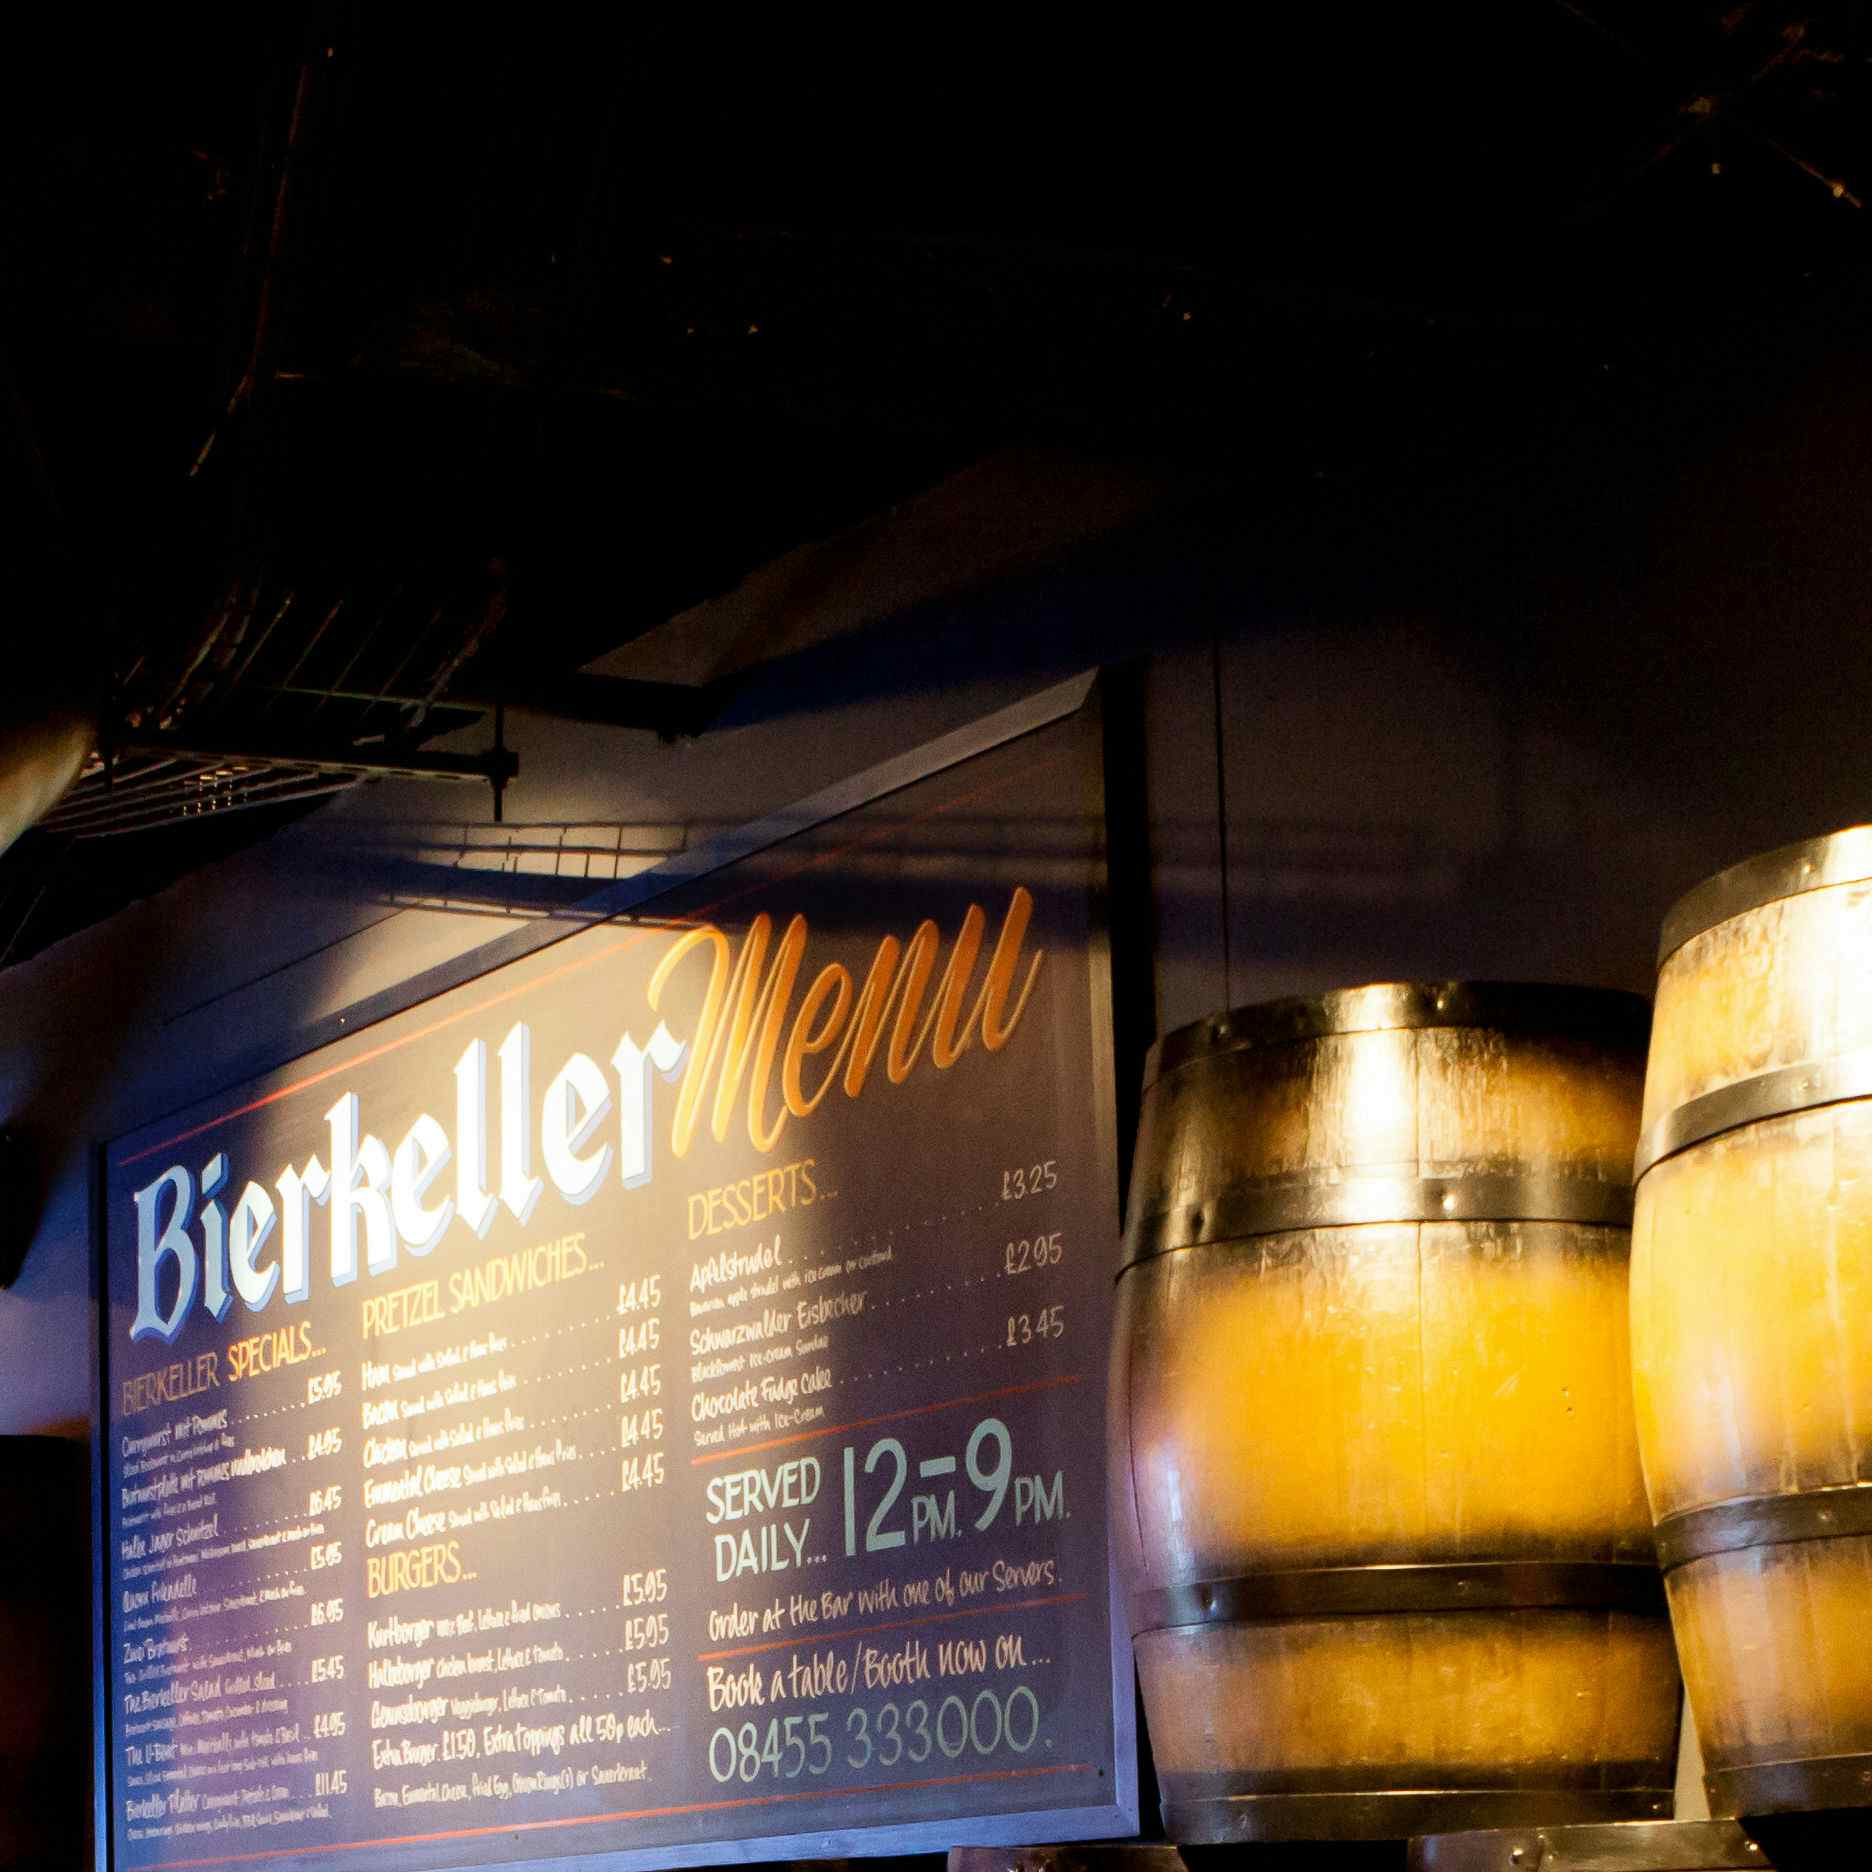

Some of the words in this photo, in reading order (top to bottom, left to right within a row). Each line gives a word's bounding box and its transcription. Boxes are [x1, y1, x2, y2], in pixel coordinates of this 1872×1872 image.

[129, 1020, 686, 1347] Bierkeller
[646, 886, 1044, 1158] Menu
[362, 1280, 445, 1340] PRETZEL
[123, 1352, 220, 1416] BIERKELLER
[691, 1379, 760, 1422] Chocolate
[761, 1375, 799, 1406] Fudge
[705, 1456, 821, 1525] SERVED
[762, 1598, 786, 1633] at
[789, 1593, 819, 1627] the
[821, 1590, 854, 1620] Bar
[857, 1576, 899, 1616] with
[902, 1578, 930, 1608] one
[934, 1567, 956, 1607] of
[959, 1569, 989, 1598] our
[707, 1663, 765, 1713] Book
[769, 1669, 787, 1701] a
[939, 1639, 988, 1675] now
[569, 1714, 595, 1746] all
[595, 1712, 625, 1744] 50p
[708, 1711, 833, 1784] 08455
